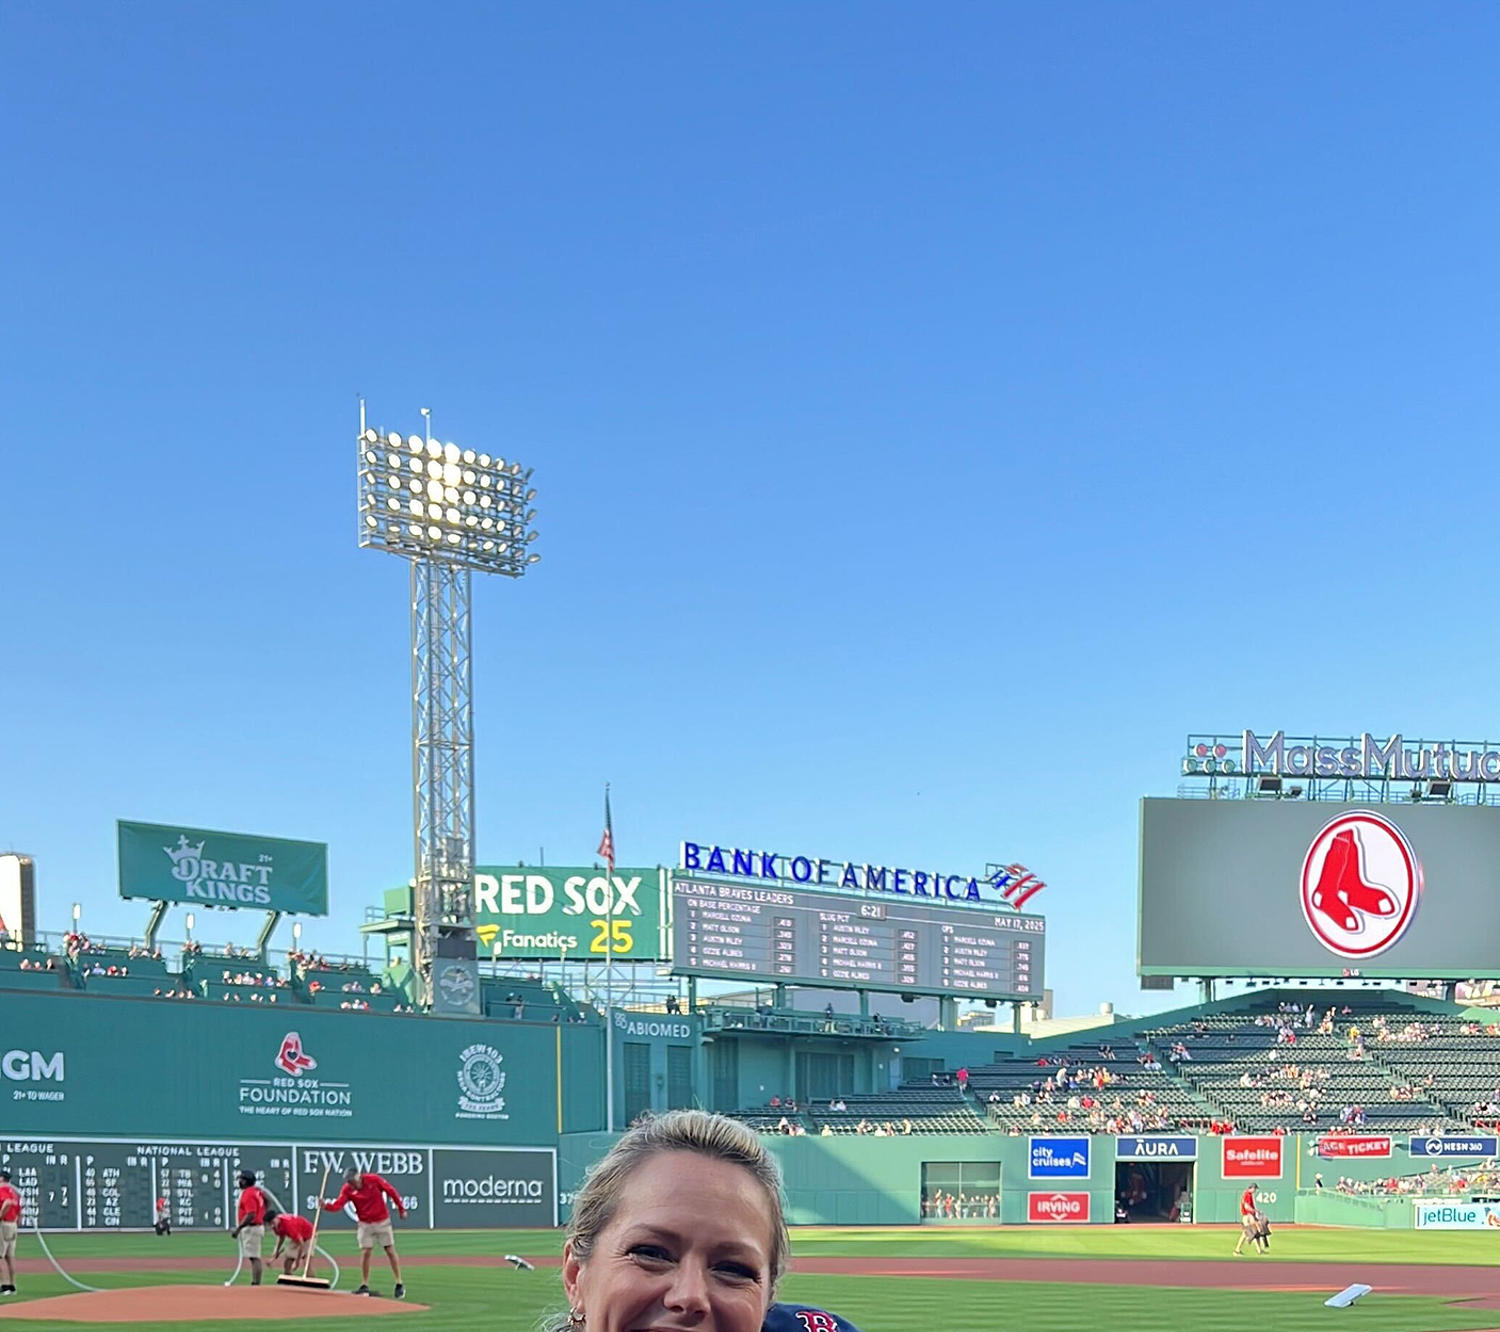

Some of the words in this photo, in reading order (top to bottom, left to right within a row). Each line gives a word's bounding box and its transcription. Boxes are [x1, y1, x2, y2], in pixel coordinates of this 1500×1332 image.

[171, 857, 273, 885] DRAFT
[680, 841, 778, 879] BANK
[788, 855, 831, 884] OF
[839, 861, 981, 902] AMERICA
[186, 877, 271, 904] KINGS
[474, 873, 554, 915] RED
[562, 876, 643, 916] SOX
[675, 882, 717, 895] ATLANTA
[719, 886, 752, 901] BRAVES
[755, 891, 794, 905] LEADERS
[994, 917, 1011, 928] MAY
[1025, 920, 1044, 931] 2025
[699, 900, 717, 909] BASE
[718, 901, 760, 914] PERCENTAGE
[503, 930, 578, 948] Fanatics
[589, 919, 634, 953] 25
[627, 1022, 690, 1038] ABIOMED
[0, 1050, 64, 1081] GM
[273, 1077, 295, 1087] RED
[297, 1079, 319, 1088] SOX
[240, 1087, 351, 1105] FOUNDATION
[239, 1106, 254, 1114] THE
[255, 1106, 280, 1115] HEART
[281, 1107, 292, 1115] OF
[293, 1108, 308, 1116] RED
[309, 1108, 324, 1116] SOX
[325, 1109, 352, 1117] NATION
[7, 1143, 54, 1153] LEAGUE
[137, 1146, 192, 1156] NATIONAL
[197, 1147, 240, 1157] LEAGUE
[1347, 1140, 1389, 1155] TICKET
[1444, 1143, 1469, 1151] NESN
[1033, 1146, 1053, 1160] city
[1226, 1149, 1278, 1160] Safelite
[3, 1154, 10, 1164] P
[46, 1155, 56, 1165] IN
[60, 1154, 68, 1165] R
[87, 1155, 94, 1165] P
[162, 1157, 168, 1167] P
[234, 1159, 240, 1167] P
[304, 1151, 345, 1173] F.W.
[352, 1152, 423, 1174] WEBB
[1033, 1157, 1071, 1167] cruises
[19, 1167, 37, 1177] LAA
[103, 1168, 120, 1178] ATH
[19, 1177, 38, 1186] LAD
[443, 1175, 543, 1196] moderna
[106, 1198, 118, 1206] AZ
[1256, 1192, 1277, 1203] 420
[103, 1207, 120, 1216] CLE
[1037, 1201, 1080, 1213] IRVING
[1423, 1208, 1476, 1226] jetBlue
